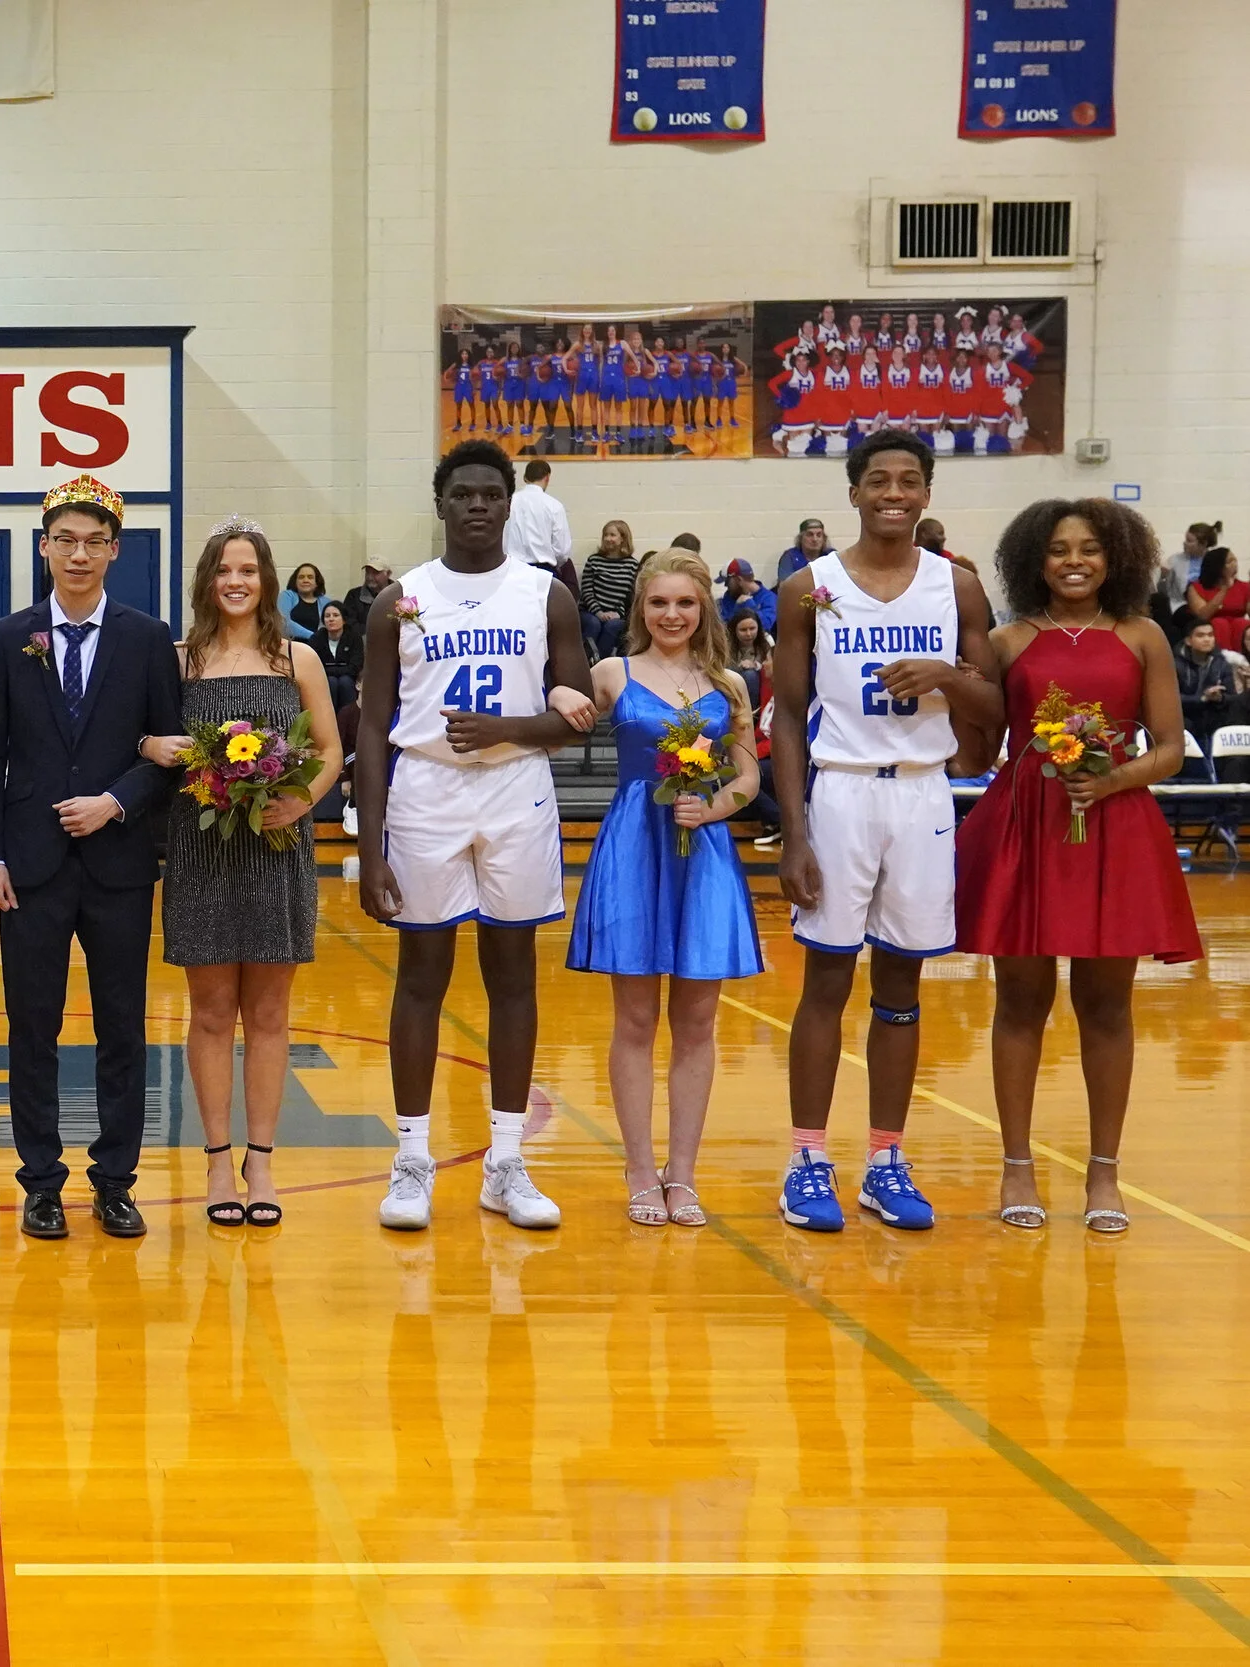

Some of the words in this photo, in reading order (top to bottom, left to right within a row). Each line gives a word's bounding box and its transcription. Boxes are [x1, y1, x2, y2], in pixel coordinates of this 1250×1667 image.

[669, 112, 711, 125] LIONS
[1015, 108, 1059, 122] LIONS
[423, 628, 526, 662] HARDING
[834, 626, 943, 654] HARDING
[444, 664, 503, 717] 42
